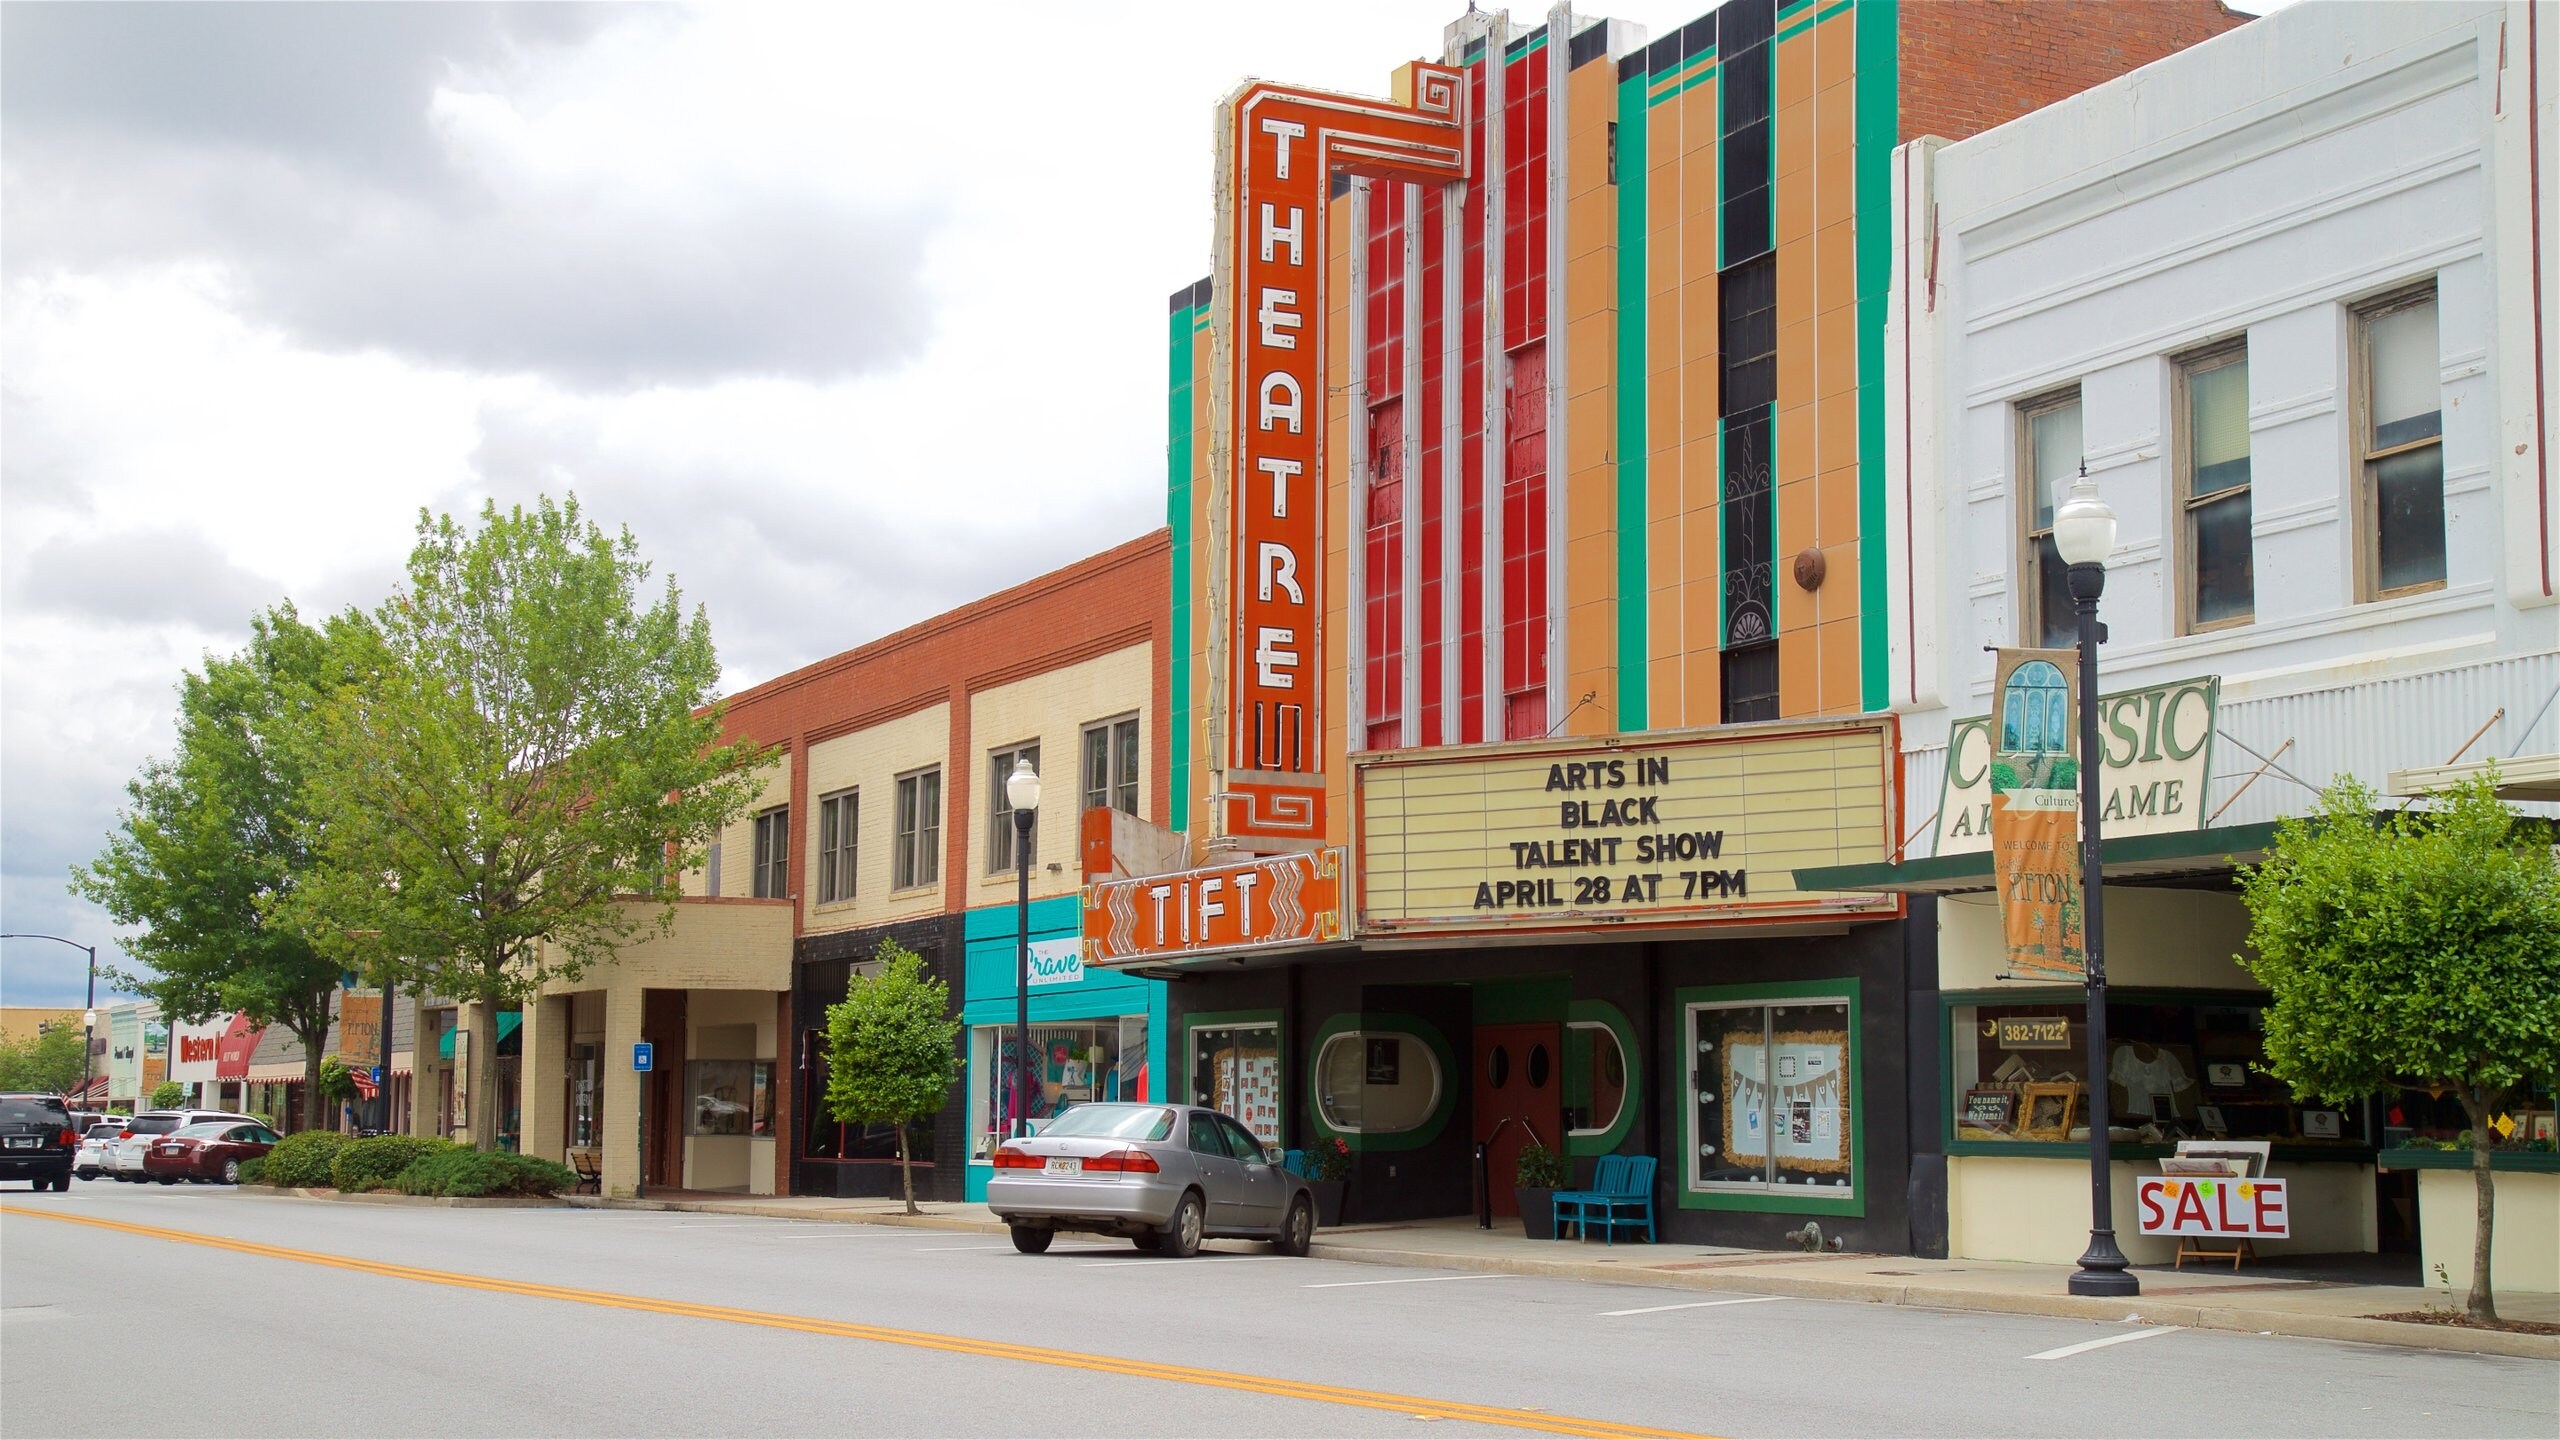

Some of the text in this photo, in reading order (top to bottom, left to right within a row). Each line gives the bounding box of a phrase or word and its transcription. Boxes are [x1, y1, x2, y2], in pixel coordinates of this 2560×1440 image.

[1257, 117, 1305, 690] THEATRE
[1949, 686, 2210, 790] CSIC
[1545, 756, 1669, 792] ARTS IN
[1561, 796, 1661, 829] BLACK
[2034, 795, 2075, 807] Culture
[1510, 830, 1723, 869] TALENT SHOW
[2003, 840, 2070, 851] WELCOME TO
[1473, 869, 1746, 909] APRIL 28 AT 7PM
[2009, 872, 2070, 904] TIFTON
[1151, 872, 1257, 947] TIFT
[1032, 974, 1079, 984] UNLIMITED
[180, 1036, 214, 1063] Western
[2005, 1024, 2064, 1041] 382-7122
[2140, 1181, 2286, 1234] SALE
